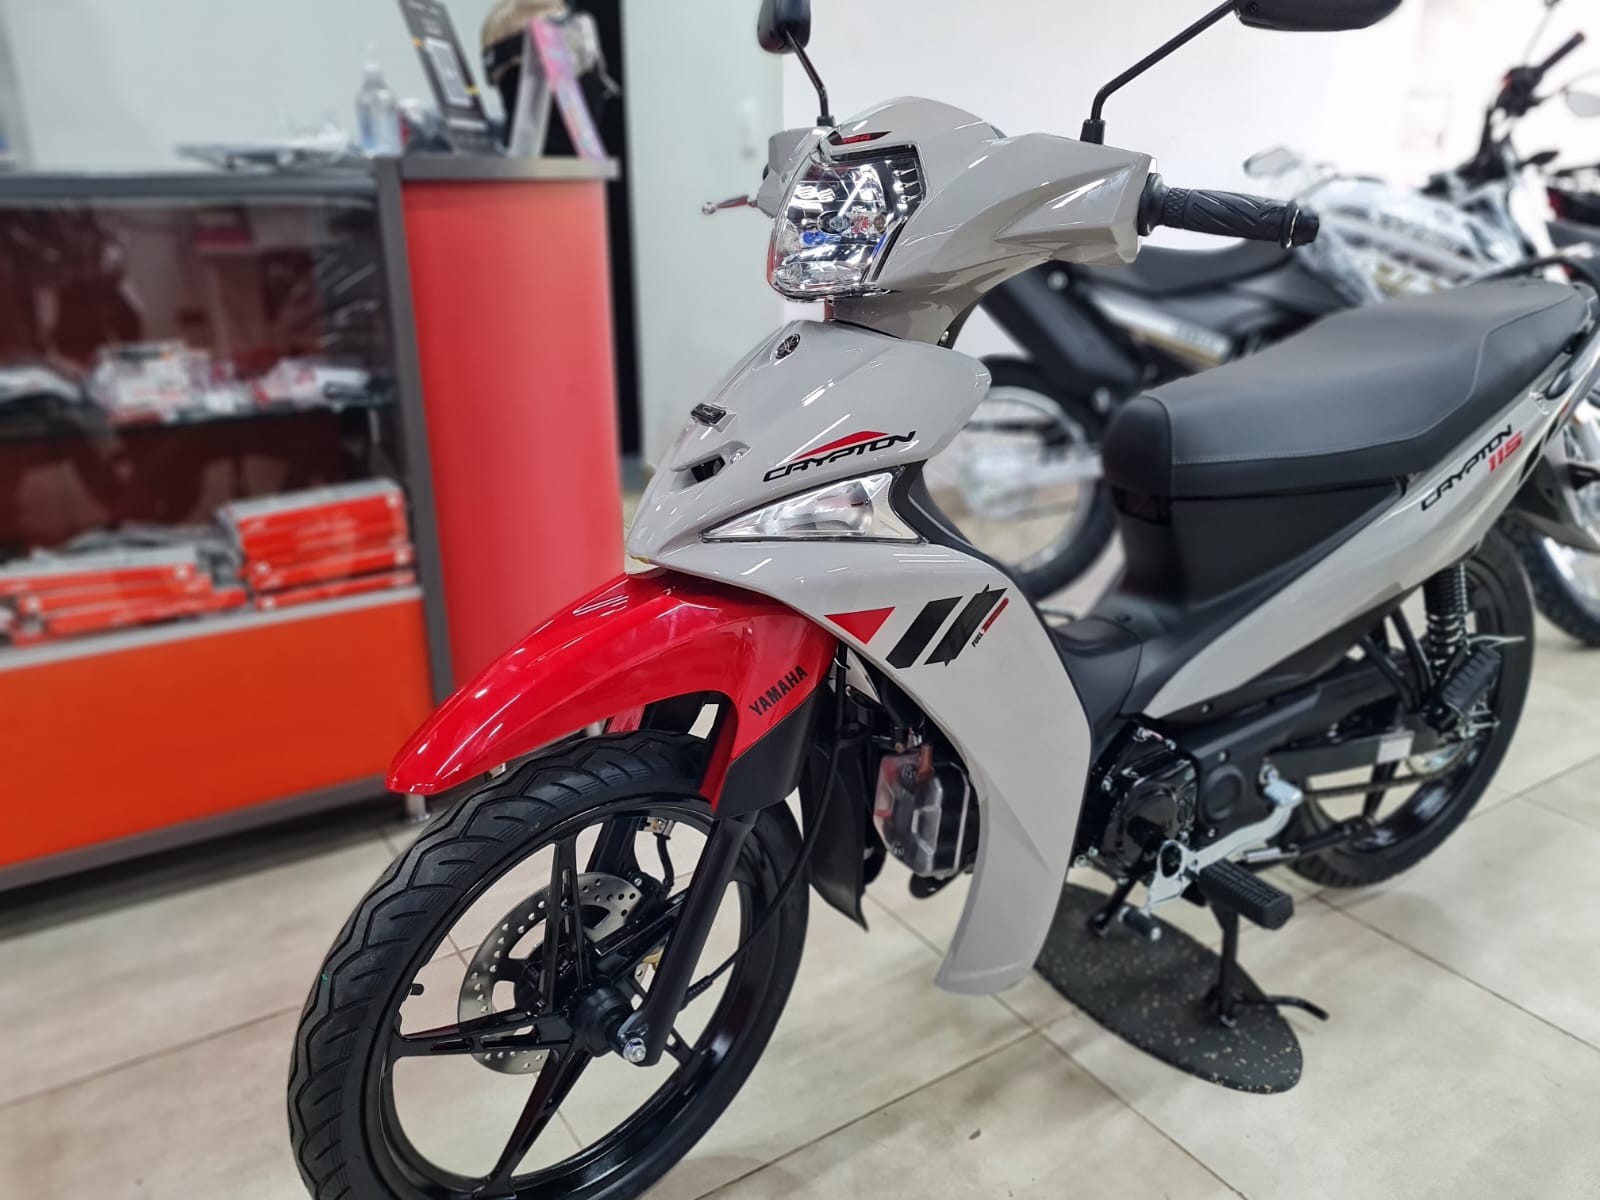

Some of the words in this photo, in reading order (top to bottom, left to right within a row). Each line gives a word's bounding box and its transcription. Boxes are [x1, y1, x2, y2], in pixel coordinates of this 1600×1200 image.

[763, 430, 916, 482] CRYPTON
[1421, 424, 1512, 511] CRYPTON
[1489, 432, 1522, 472] 115
[748, 664, 809, 717] YAMAHA
